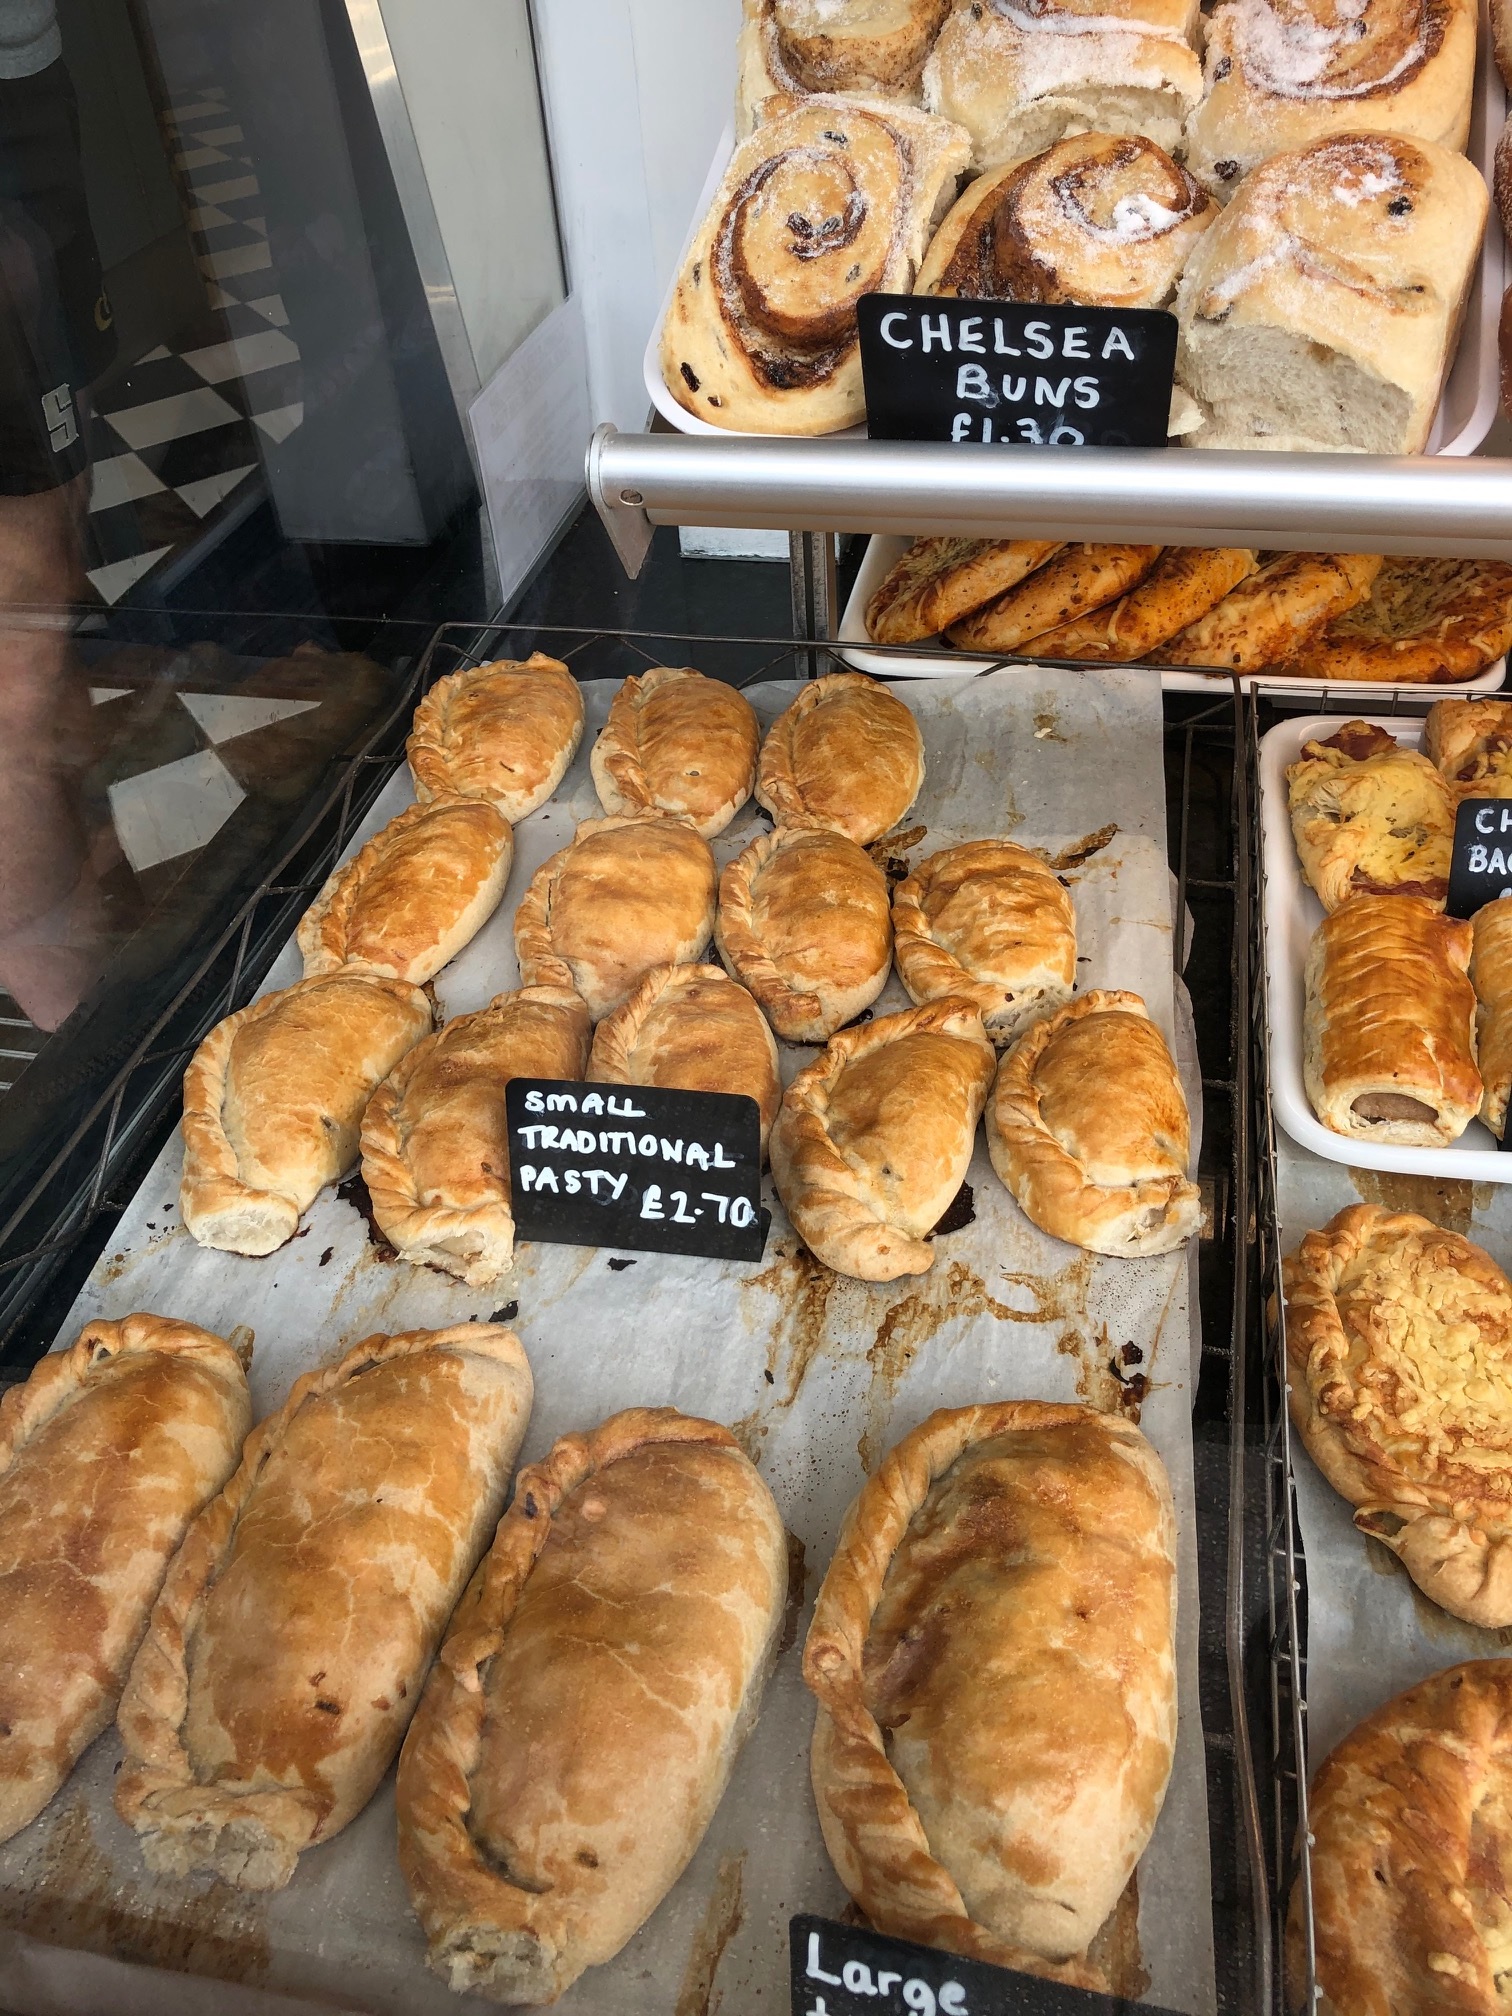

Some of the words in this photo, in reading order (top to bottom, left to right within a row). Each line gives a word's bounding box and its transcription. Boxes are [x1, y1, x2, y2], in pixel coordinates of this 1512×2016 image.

[880, 312, 1135, 360] CHELSEA
[956, 363, 1100, 408] BUNS
[1467, 844, 1512, 875] BA
[517, 1125, 736, 1170] TRADITIONAL
[519, 1165, 628, 1200] PASTY
[639, 1184, 756, 1227] £2.70
[806, 1931, 969, 2016] Large
